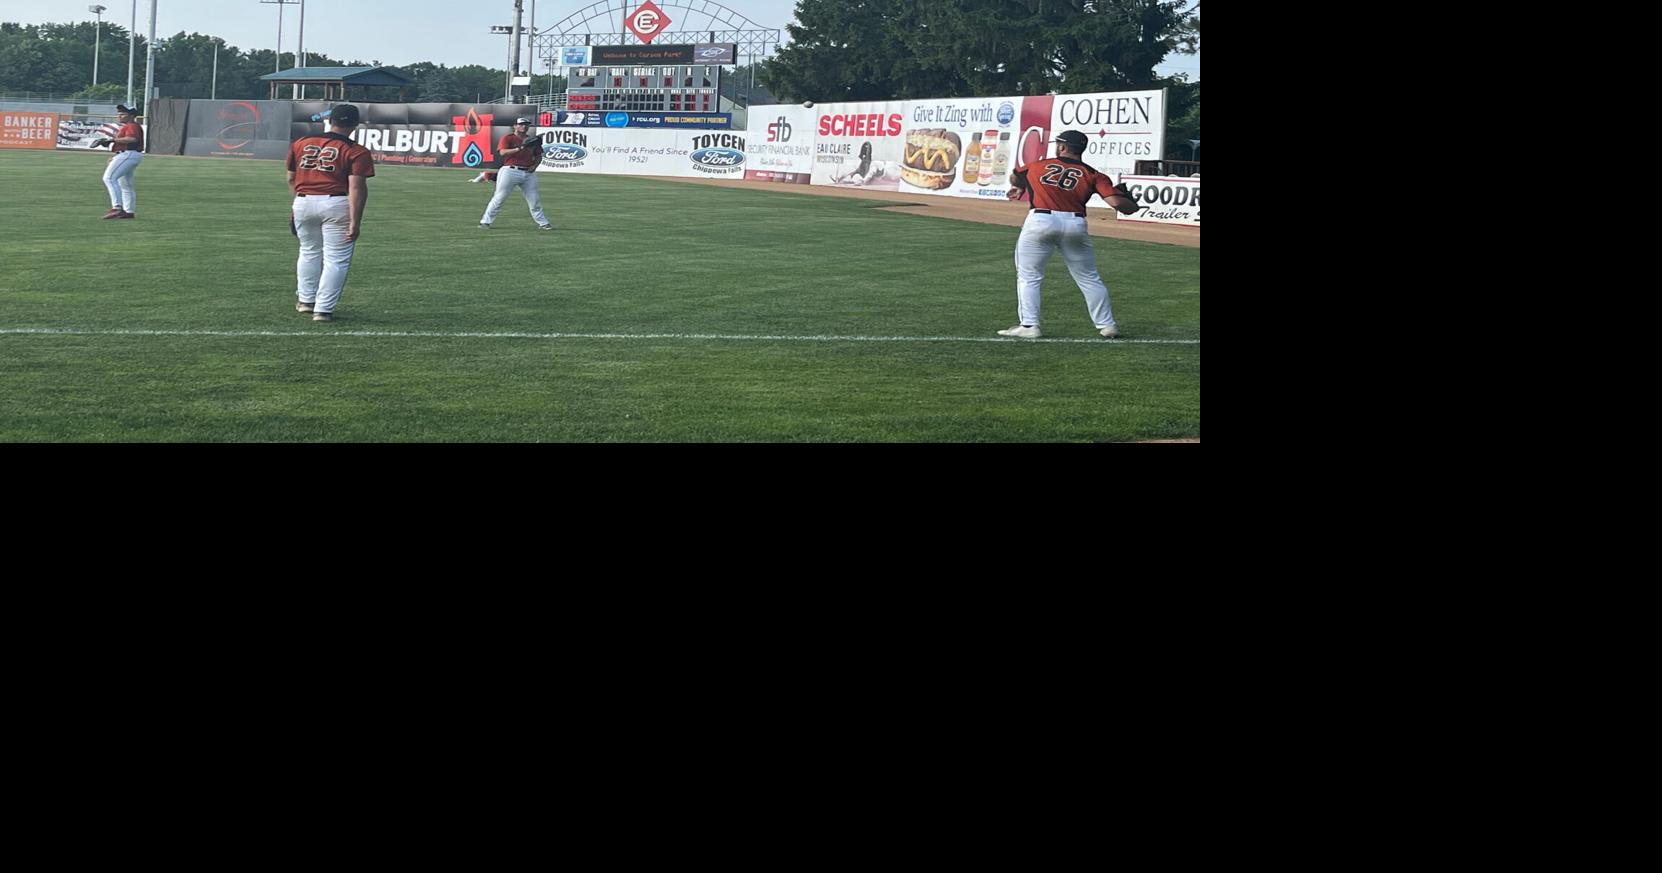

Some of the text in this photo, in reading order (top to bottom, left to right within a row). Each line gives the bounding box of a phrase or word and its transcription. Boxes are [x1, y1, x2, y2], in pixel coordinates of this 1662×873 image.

[633, 68, 656, 77] STRIKE
[913, 105, 933, 122] Give
[935, 105, 943, 122] It
[944, 104, 968, 127] Zing
[970, 103, 993, 123] with
[1060, 97, 1152, 126] COHEN
[4, 115, 53, 128] BANKER
[636, 116, 660, 124] rcu.org
[818, 113, 903, 137] SCHEELS
[21, 128, 51, 140] BEER
[324, 119, 466, 154] URLBURT
[767, 116, 792, 143] sfb
[541, 130, 588, 147] TOYCEN
[692, 133, 746, 151] TOYCEN
[547, 147, 576, 160] Ford
[592, 145, 689, 156] You'll Find A Friend Since
[816, 143, 851, 155] EAU CLAIRE
[1089, 141, 1152, 156] OFFICES
[300, 145, 339, 172] 22
[701, 150, 737, 166] Ford
[816, 155, 844, 164] WISCONSIN
[1039, 164, 1083, 192] 26
[1138, 206, 1190, 220] Trailer
